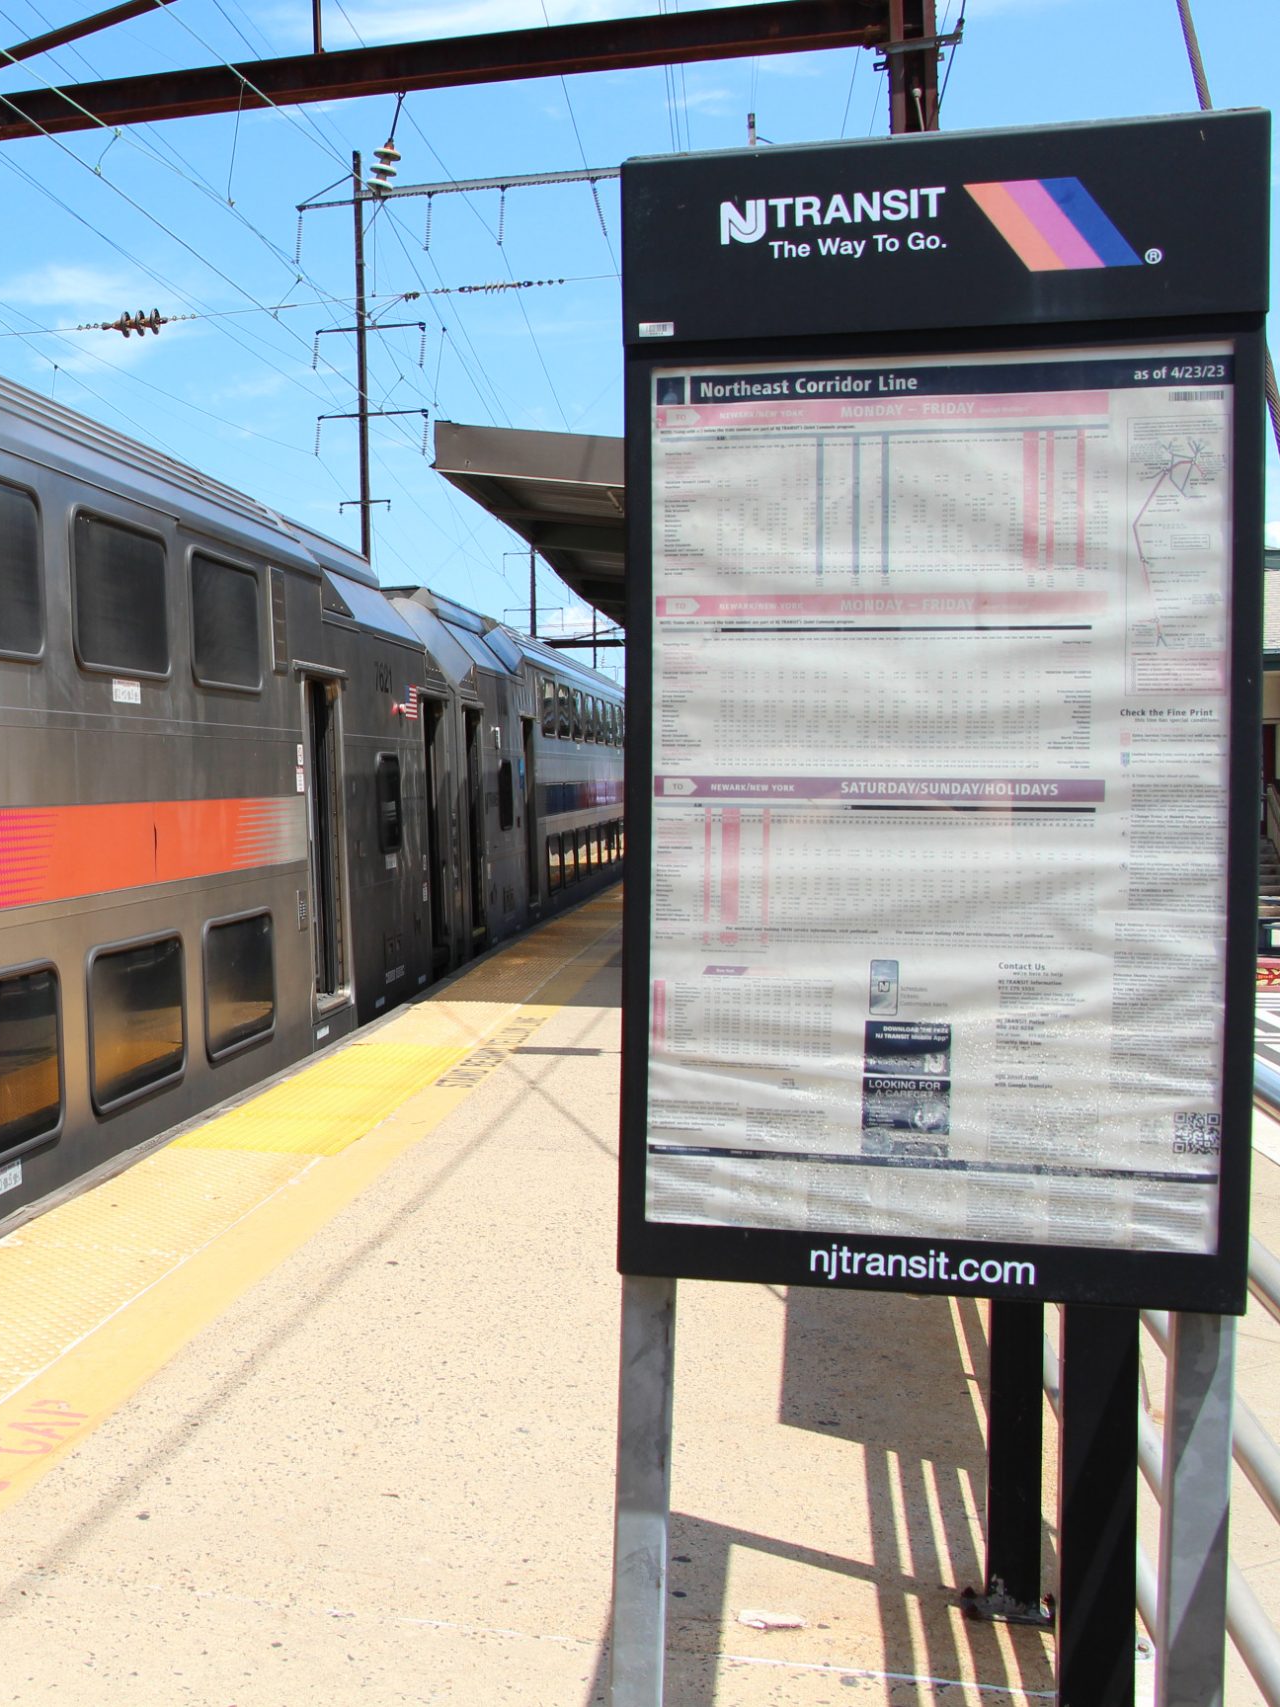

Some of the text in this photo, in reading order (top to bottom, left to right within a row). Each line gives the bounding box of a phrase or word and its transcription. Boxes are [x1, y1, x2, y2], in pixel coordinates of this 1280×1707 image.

[768, 187, 946, 228] TRANSIT
[769, 231, 948, 260] The Way To Go.
[1133, 364, 1226, 381] as of 4/23/23
[700, 374, 918, 398] Northeast Corridor Line
[840, 404, 904, 418] MONDAY
[923, 401, 976, 415] FRIDAY
[840, 599, 903, 613] MONDAY
[922, 598, 976, 612] FRIDAY
[373, 660, 393, 695] 7621
[1120, 708, 1214, 717] Check the Fine Print
[672, 782, 684, 791] TO
[710, 783, 796, 793] NEWARK/NEW YORK
[840, 781, 1059, 796] SATURDAY/SUNDAY/HOLIDAYS
[998, 961, 1046, 971] Contact Us
[883, 1025, 919, 1033] DOWNLOAD
[869, 1080, 941, 1090] LOOKING FOR
[809, 1243, 1036, 1285] njtransit.com
